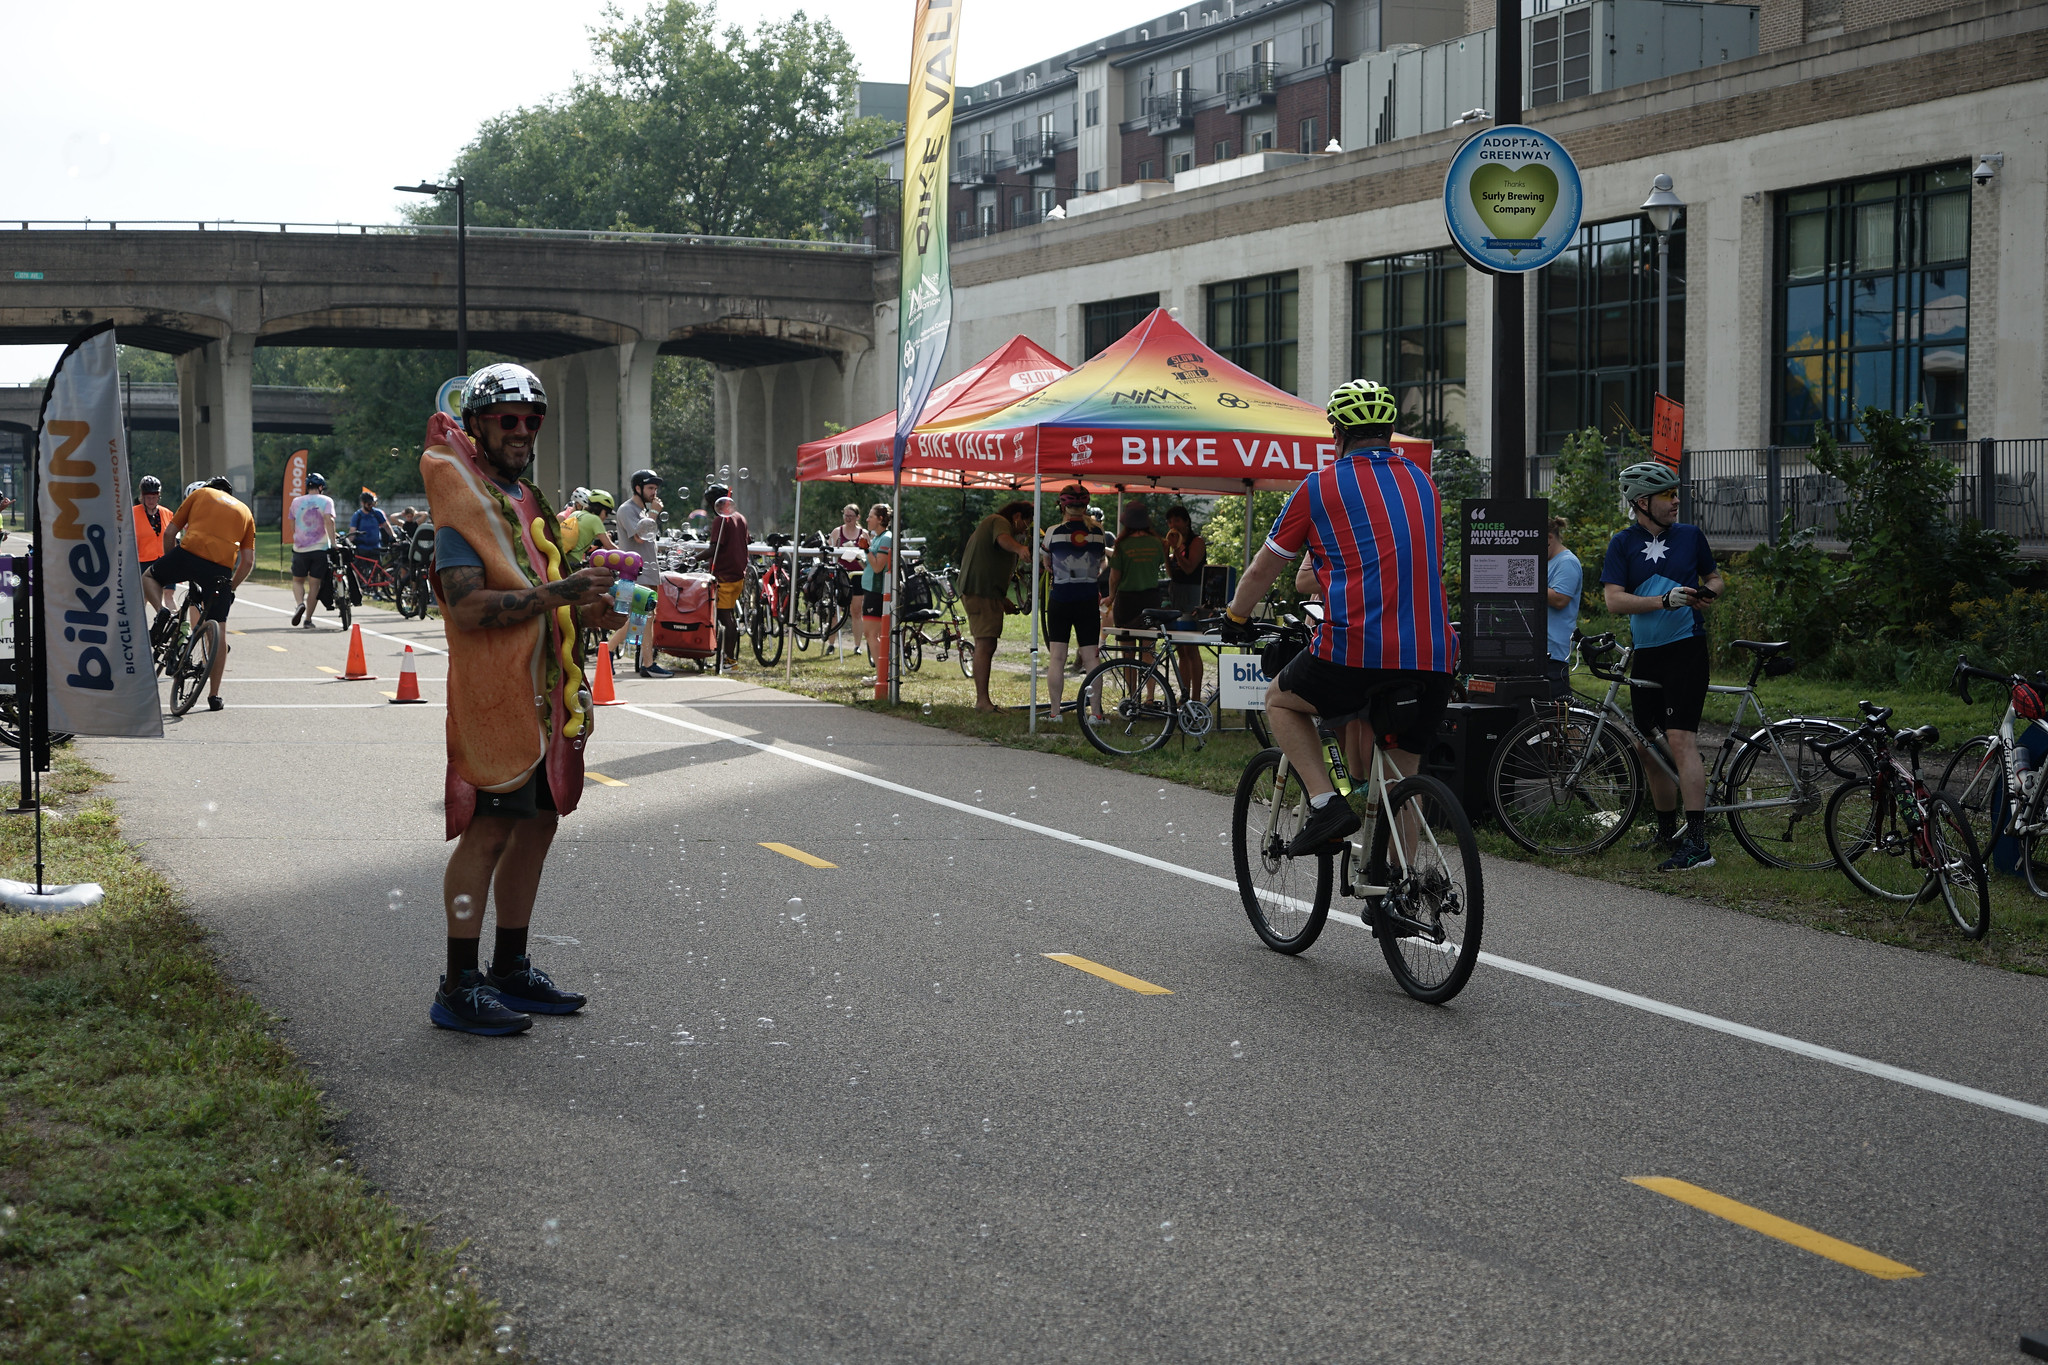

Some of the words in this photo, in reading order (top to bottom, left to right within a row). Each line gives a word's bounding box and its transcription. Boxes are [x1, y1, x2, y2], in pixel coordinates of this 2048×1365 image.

[925, 0, 952, 120] VAL
[1483, 138, 1544, 148] ADOPT-A-
[1479, 150, 1551, 160] GREENWAY
[1504, 180, 1525, 188] Thanks
[1482, 191, 1505, 202] Surly
[1507, 191, 1545, 202] Brewing
[1493, 204, 1536, 215] Company
[1531, 248, 1553, 262] Greenway
[1173, 353, 1196, 364] SLOW
[1018, 370, 1055, 385] SLOW
[1183, 370, 1204, 380] ROLL
[1657, 413, 1661, 435] E
[1673, 421, 1680, 442] ST
[918, 432, 953, 458] BIKE
[955, 433, 1006, 461] VALET
[1121, 436, 1219, 466] BIKE
[1232, 438, 1336, 471] VALE
[108, 438, 124, 522] MINNESOTA
[1470, 522, 1505, 530] VOICES
[1470, 529, 1539, 538] MINNEAPOLIS
[1470, 537, 1493, 545] MAY
[1494, 537, 1519, 545] 2020
[116, 549, 128, 616] ALLIANCE
[118, 620, 135, 675] BICYCLE
[1233, 662, 1272, 683] bik
